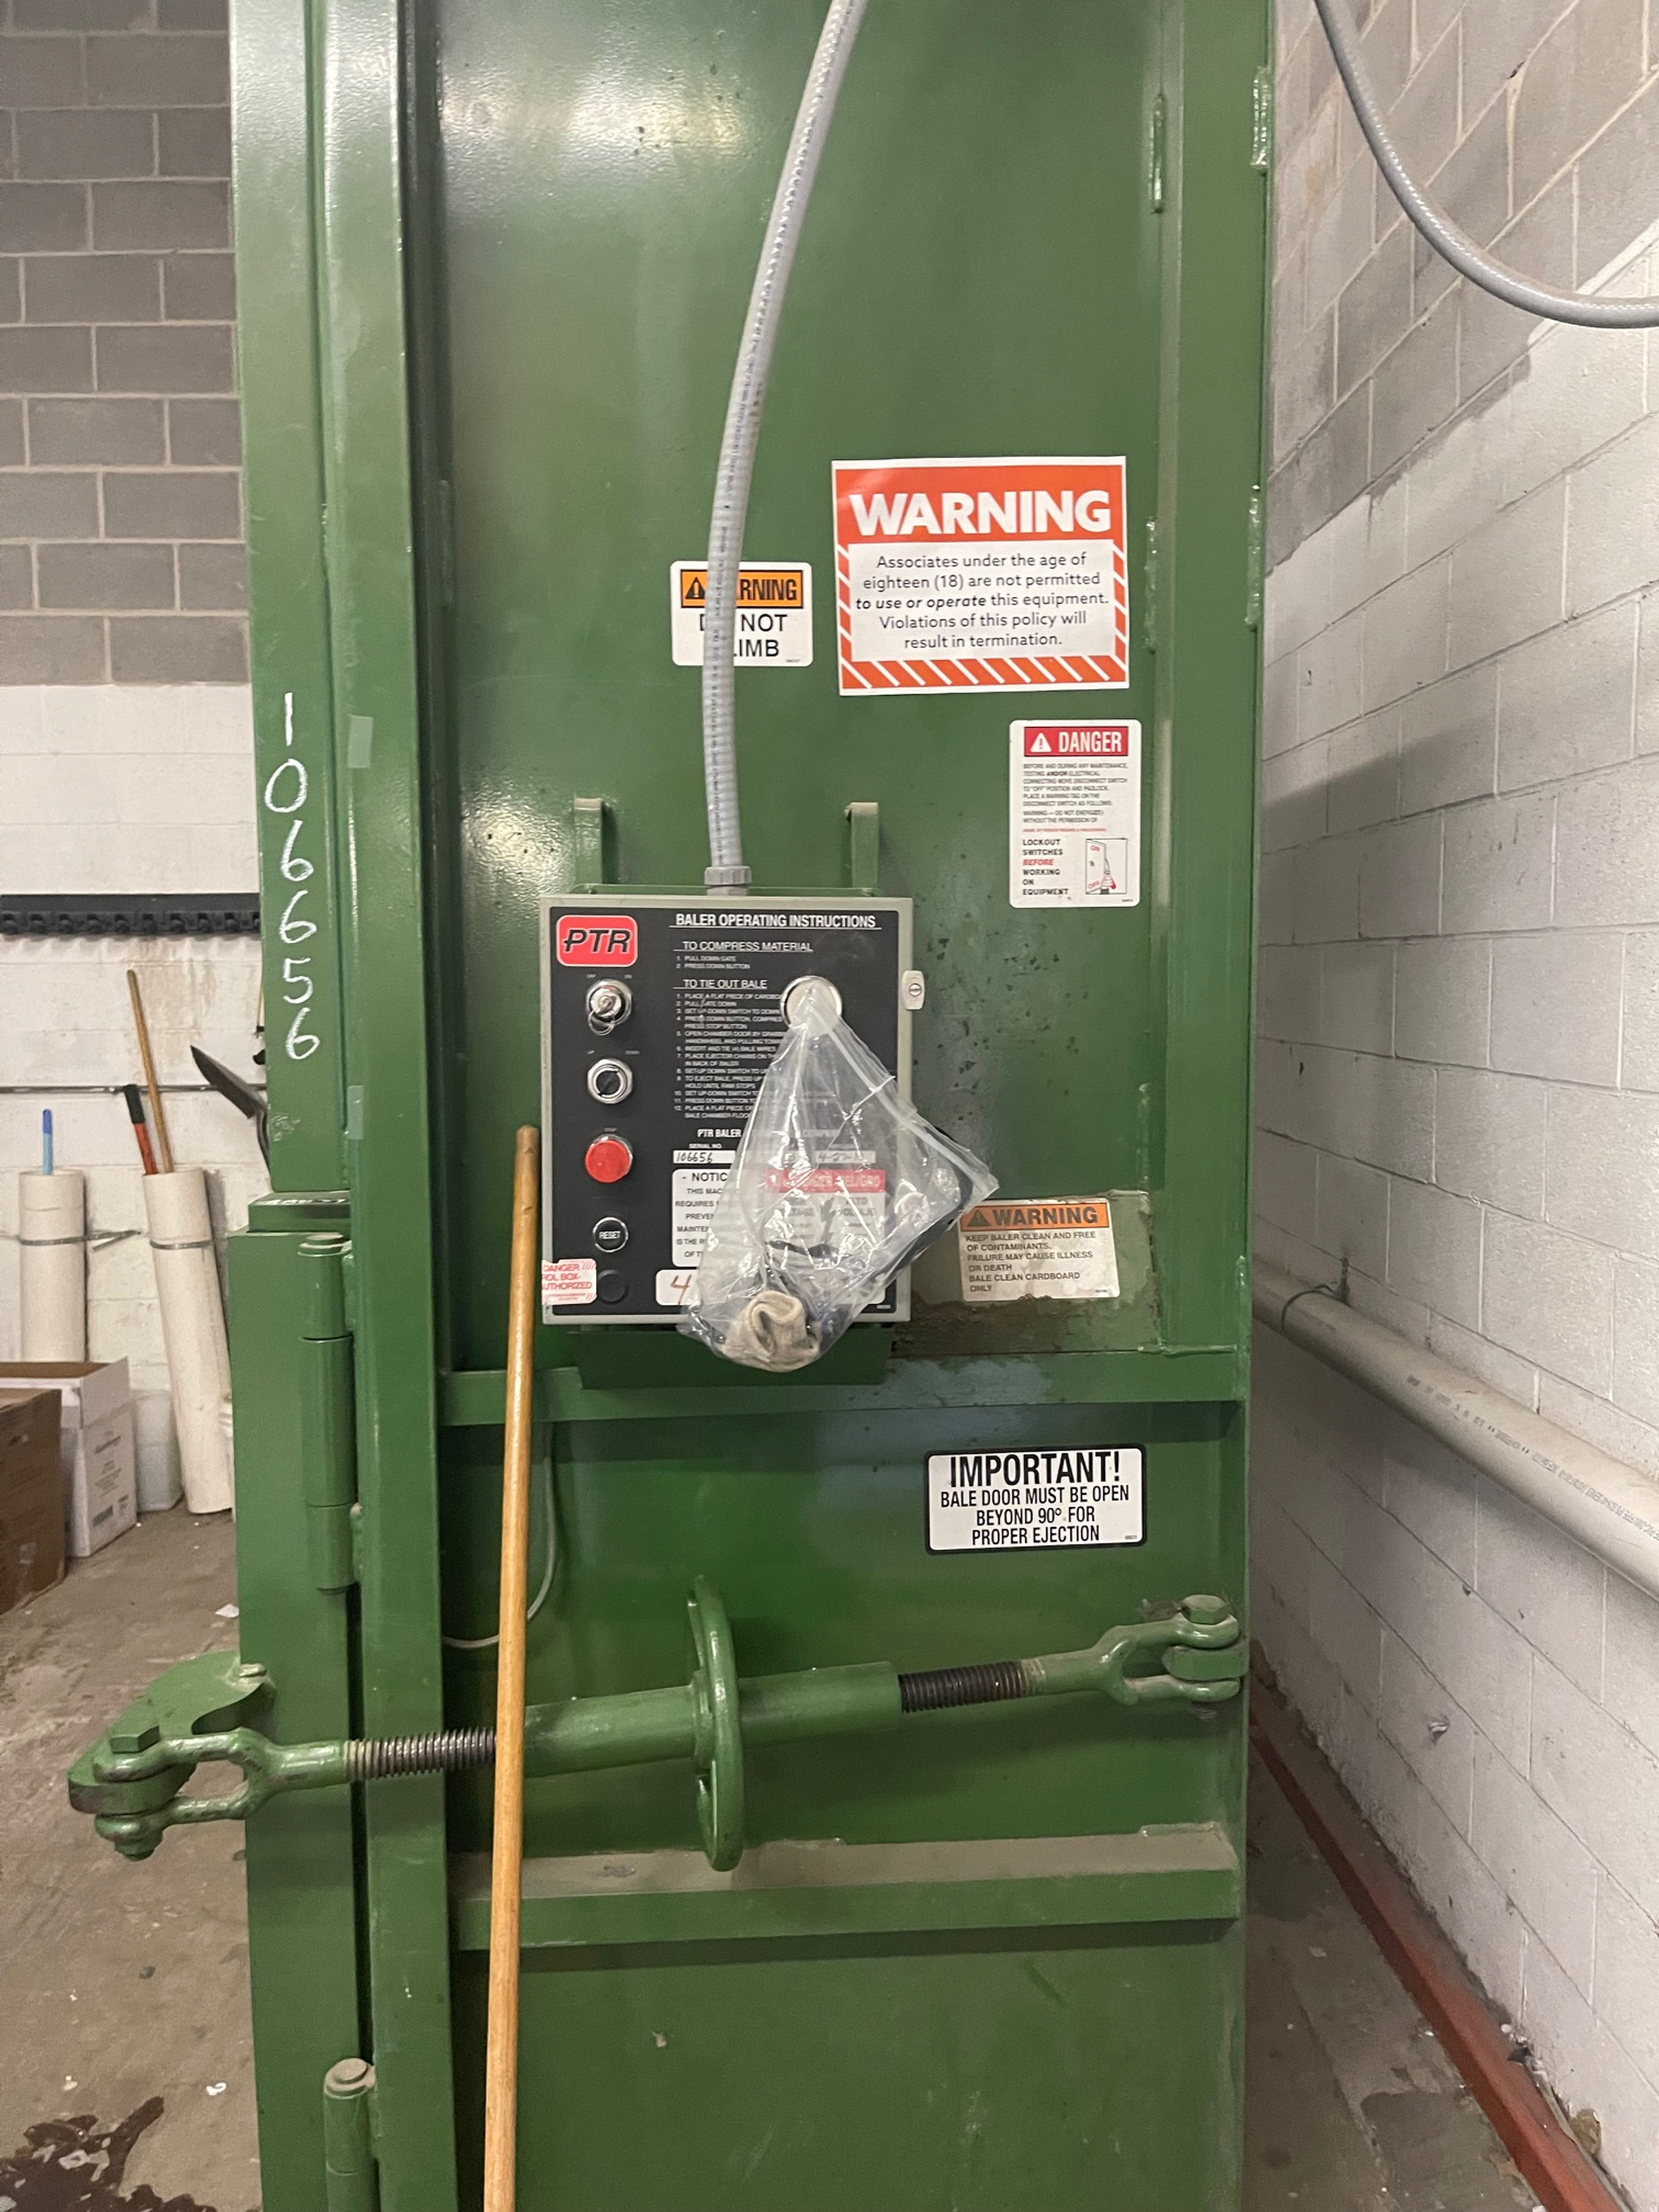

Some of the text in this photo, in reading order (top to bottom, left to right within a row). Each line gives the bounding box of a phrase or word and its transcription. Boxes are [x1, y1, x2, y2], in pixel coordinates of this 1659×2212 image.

[849, 490, 1111, 536] WARNING
[877, 552, 1086, 569] Associates under the age of
[737, 579, 796, 600] RNING
[863, 572, 1100, 592] eighteen (18) are not permitted
[856, 593, 1109, 611] to use or operate this equipment.
[741, 613, 787, 631] NOT
[879, 611, 1086, 629] Violations of this policy will
[734, 639, 779, 657] IMB
[904, 633, 1062, 648] result in termination.
[1059, 731, 1121, 753] DANGER
[265, 692, 321, 1061] 106656
[676, 914, 876, 927] BALER OPERATING INSTRUCTIONS
[563, 928, 632, 953] PTR
[682, 941, 813, 951] TO COMPRESS MATERIAL
[697, 1129, 742, 1138] PTR BALER
[676, 1152, 713, 1163] 106656
[691, 1173, 728, 1182] NOTIC
[992, 1207, 1098, 1225] WARNING
[981, 1242, 1052, 1251] CONTAMINANTS.
[950, 1451, 1119, 1487] IMPORTANT!
[941, 1485, 1129, 1508] BALE DOOR MUST BE OPEN
[976, 1508, 1033, 1526] BEYOND
[1068, 1506, 1095, 1522] FOR
[973, 1525, 1099, 1546] PROPER EJECTION
